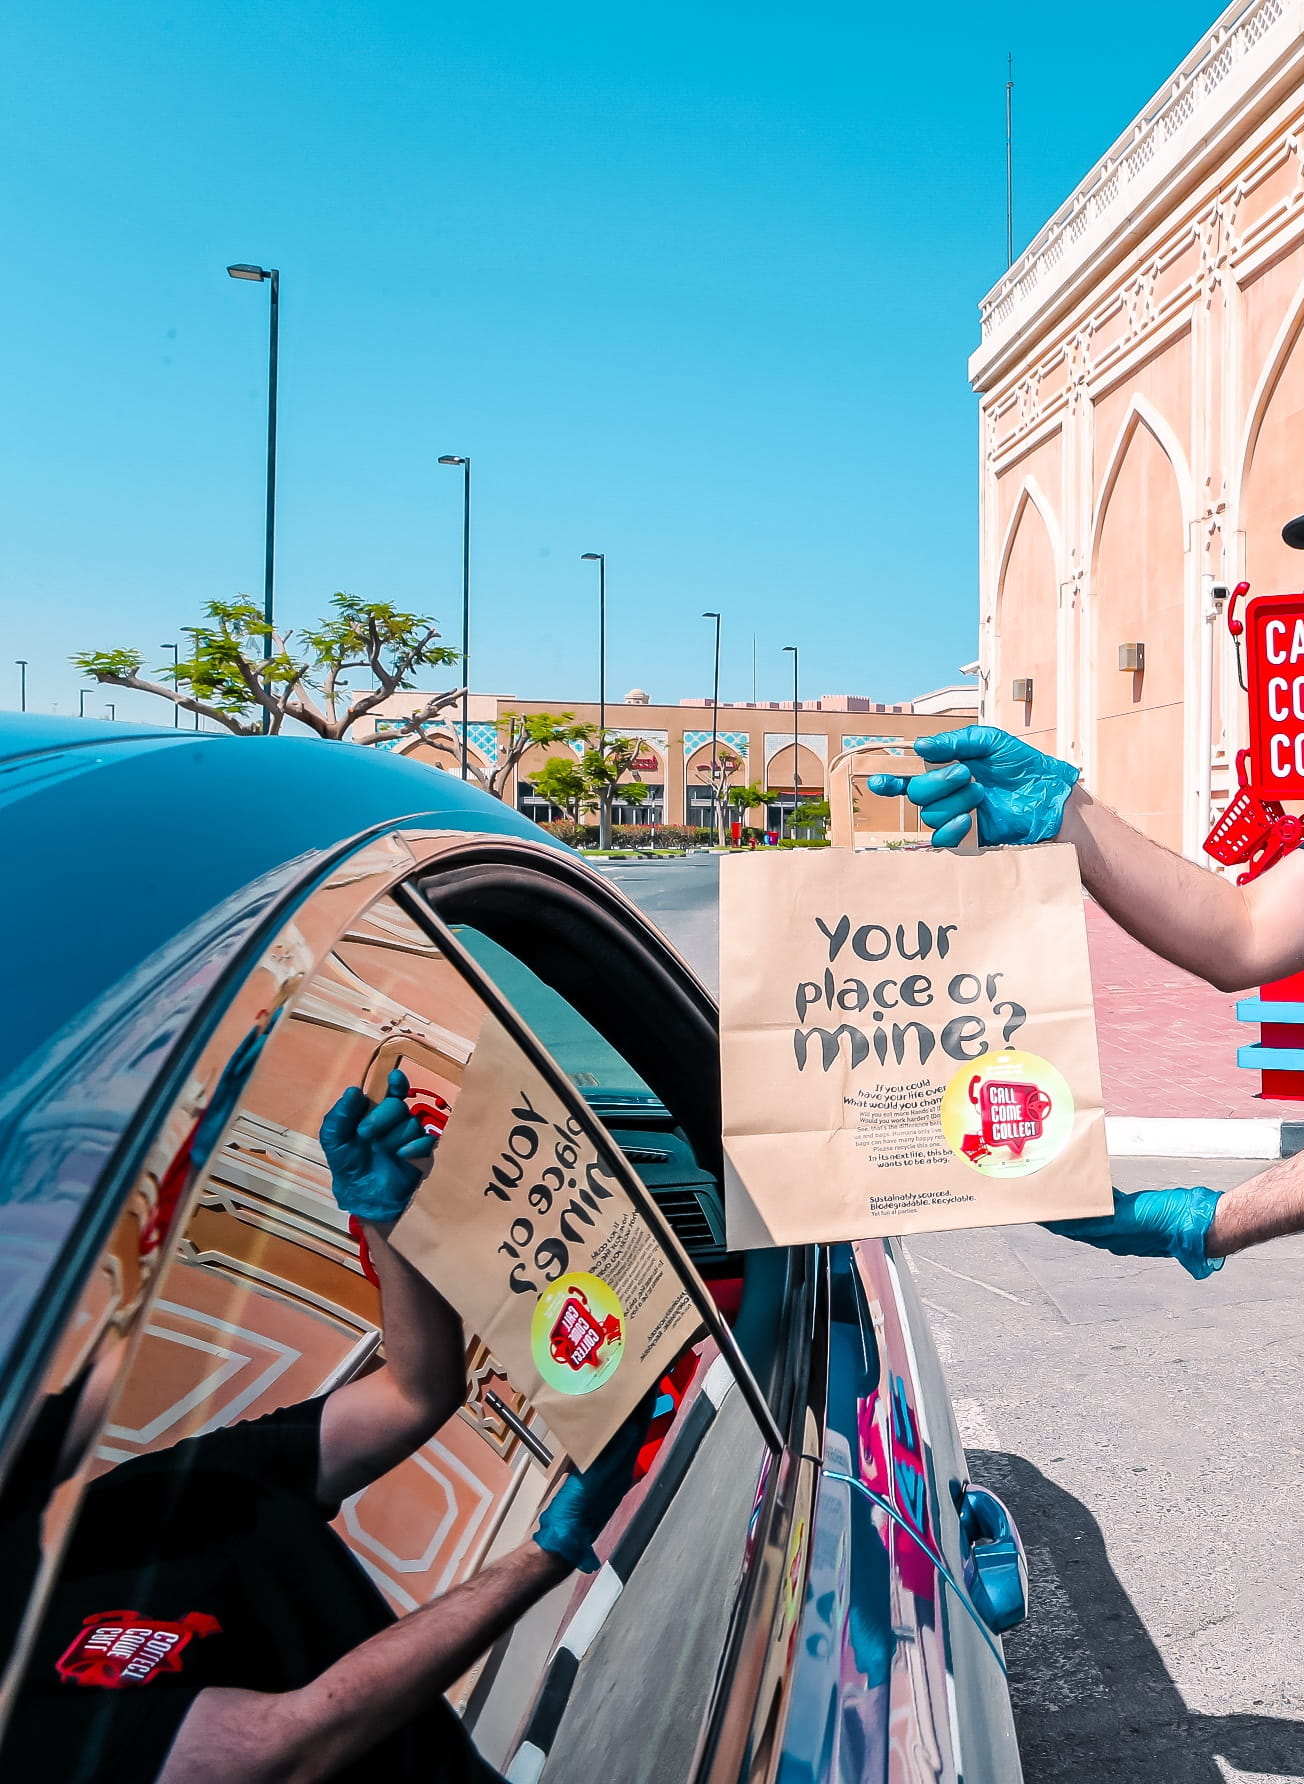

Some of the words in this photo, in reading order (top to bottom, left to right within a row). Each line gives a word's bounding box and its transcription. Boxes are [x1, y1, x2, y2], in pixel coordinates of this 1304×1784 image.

[815, 915, 958, 962] Your
[795, 967, 934, 1024] place
[948, 973, 1004, 1004] or
[794, 1001, 1027, 1072] mine?
[885, 1085, 904, 1094] you
[906, 1079, 931, 1091] could
[989, 1086, 1017, 1103] CALL
[843, 1096, 867, 1107] What
[869, 1101, 898, 1109] would
[899, 1101, 918, 1110] you
[858, 1089, 882, 1100] have
[884, 1094, 907, 1102] your
[908, 1090, 924, 1098] life
[991, 1105, 1023, 1122] COME
[992, 1121, 1036, 1140] COLLECT
[890, 1152, 909, 1160] next
[927, 1148, 942, 1156] this
[943, 1148, 956, 1157] ba
[869, 1193, 917, 1203] Sustainably
